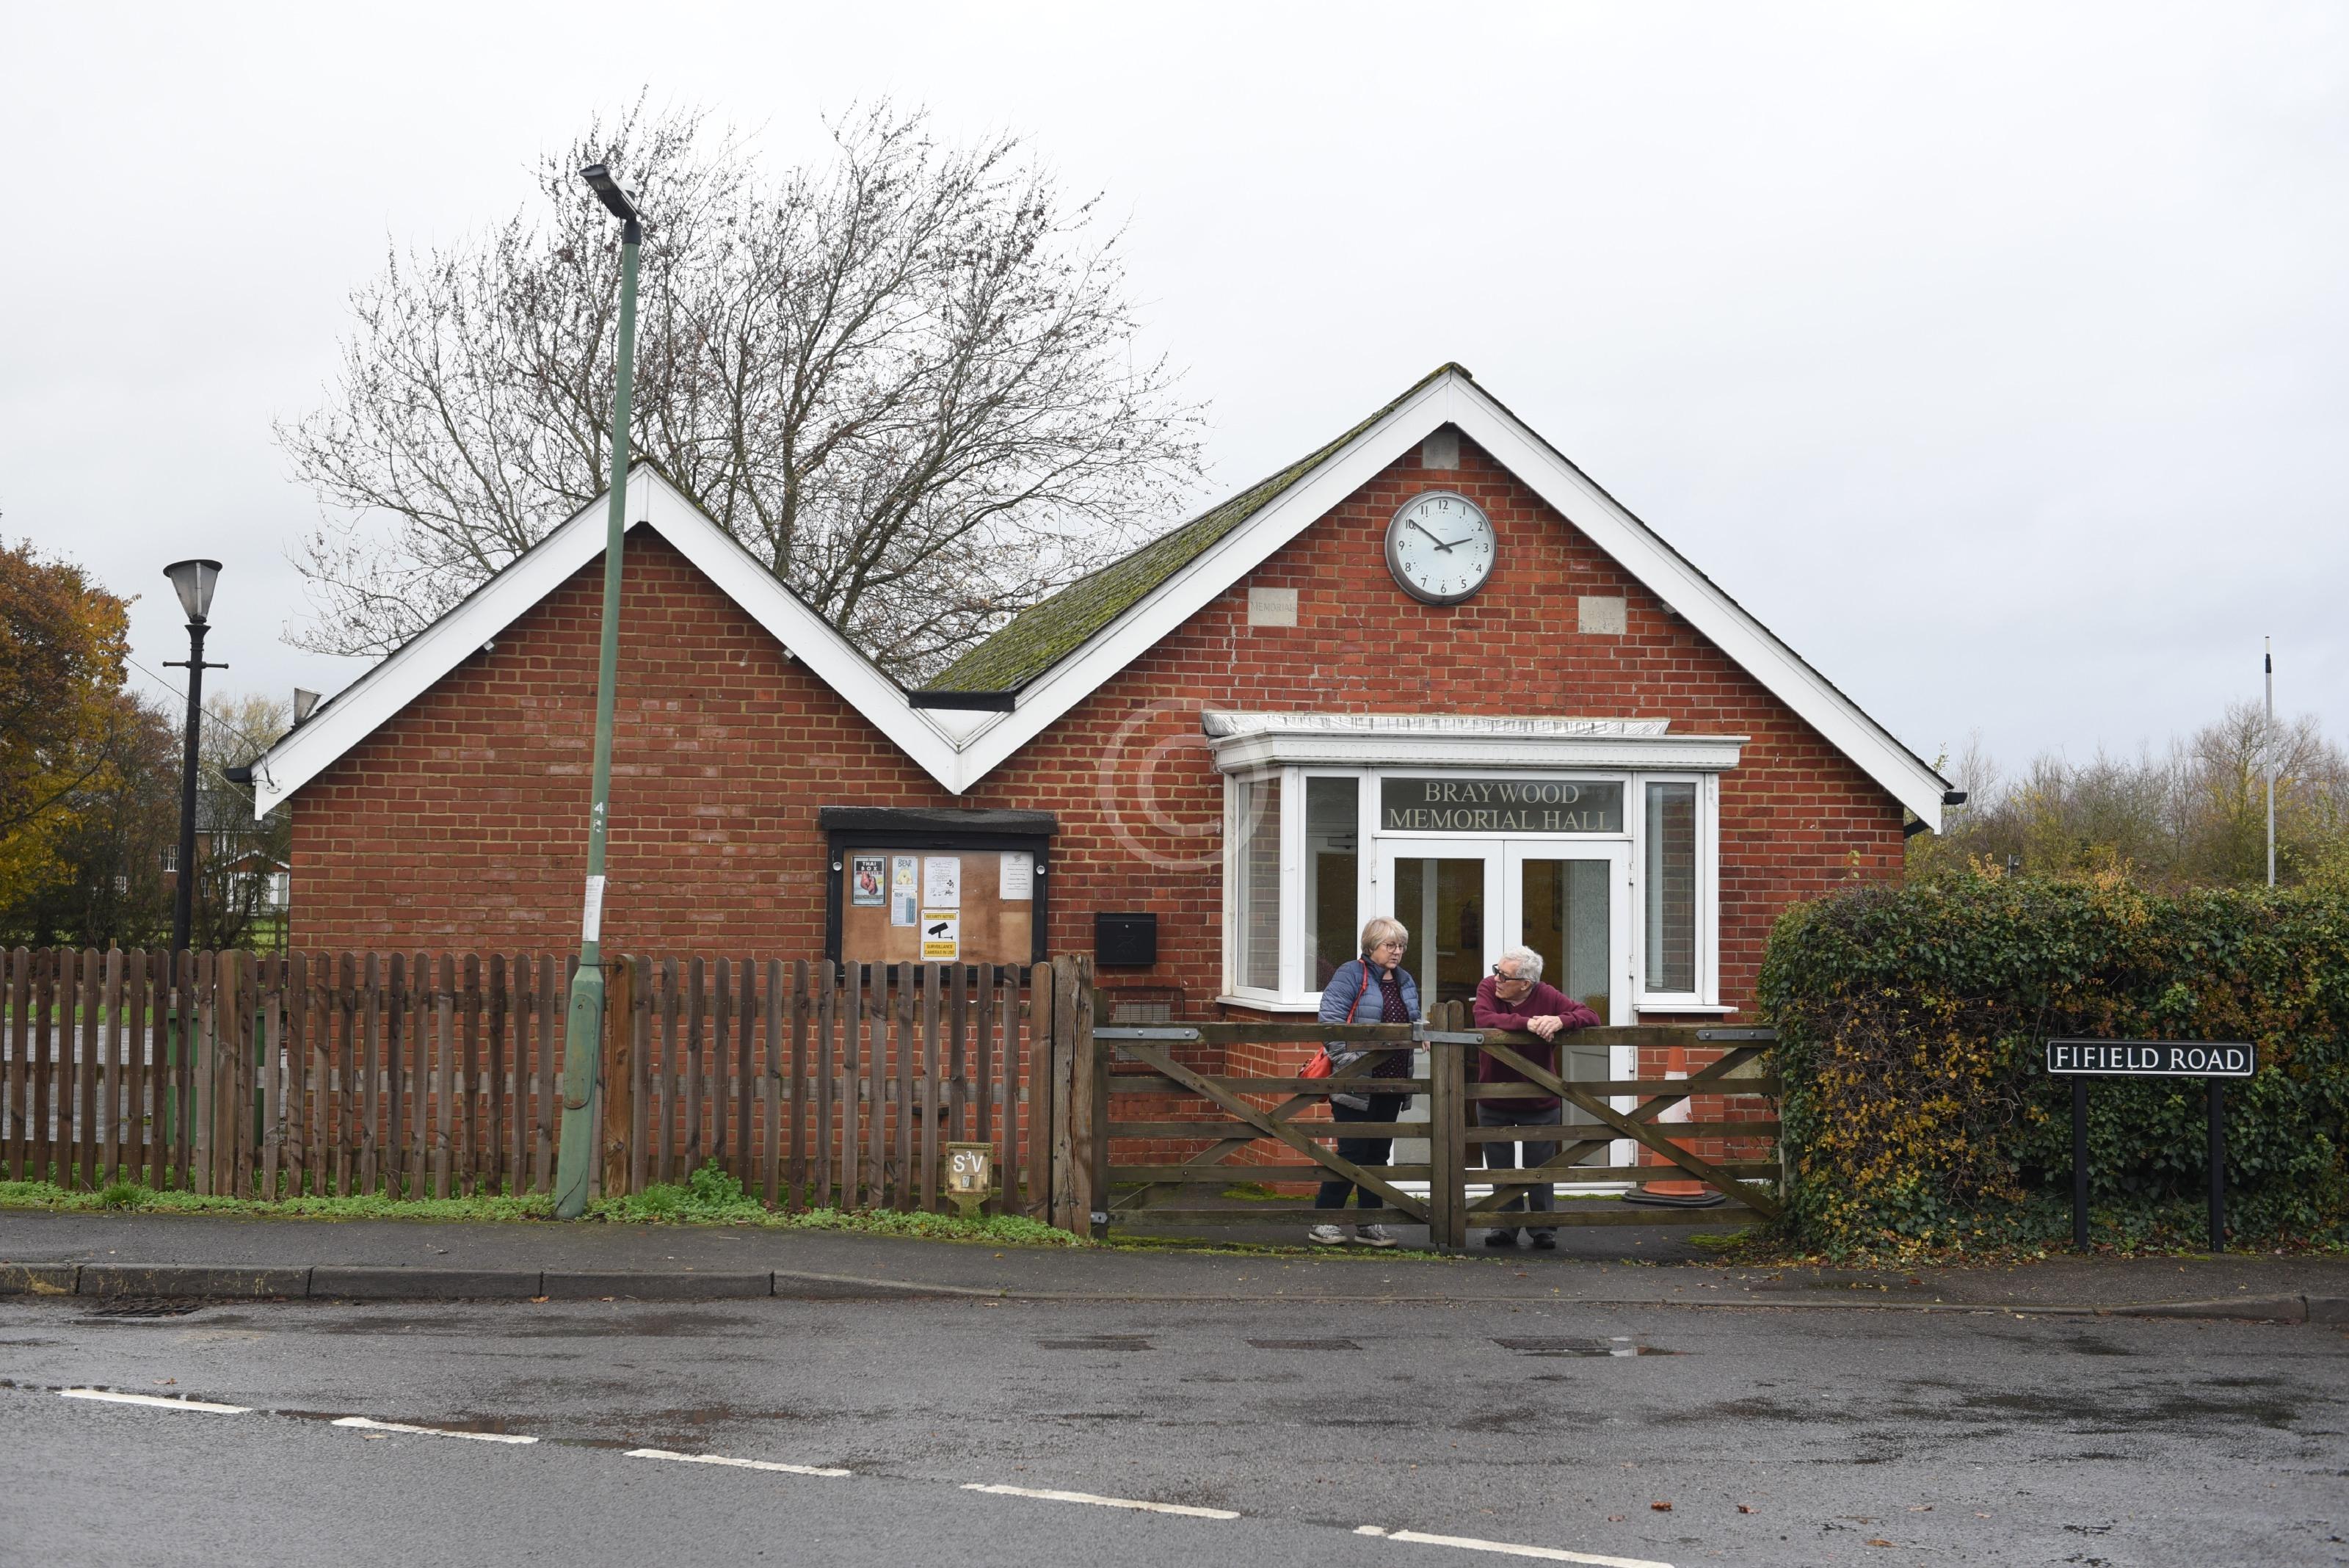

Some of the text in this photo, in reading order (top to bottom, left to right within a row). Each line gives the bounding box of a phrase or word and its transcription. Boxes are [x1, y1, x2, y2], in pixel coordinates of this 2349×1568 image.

[1439, 500, 1448, 509] 12
[1421, 505, 1428, 515] 11
[1406, 519, 1415, 529] 10
[1477, 522, 1483, 531] 2
[1398, 541, 1404, 551] 9
[1483, 543, 1489, 553] 3
[1405, 562, 1411, 572] 8
[1475, 564, 1482, 573] 4
[1421, 578, 1427, 587] 7
[1461, 579, 1467, 589] 5
[1441, 584, 1447, 593] 6
[1251, 601, 1294, 611] MEMORIAL
[1425, 782, 1579, 804] BRAYWOOD
[1388, 808, 1613, 830] MEMORIAL HALL
[2056, 1046, 2244, 1070] FIFIELD ROAD
